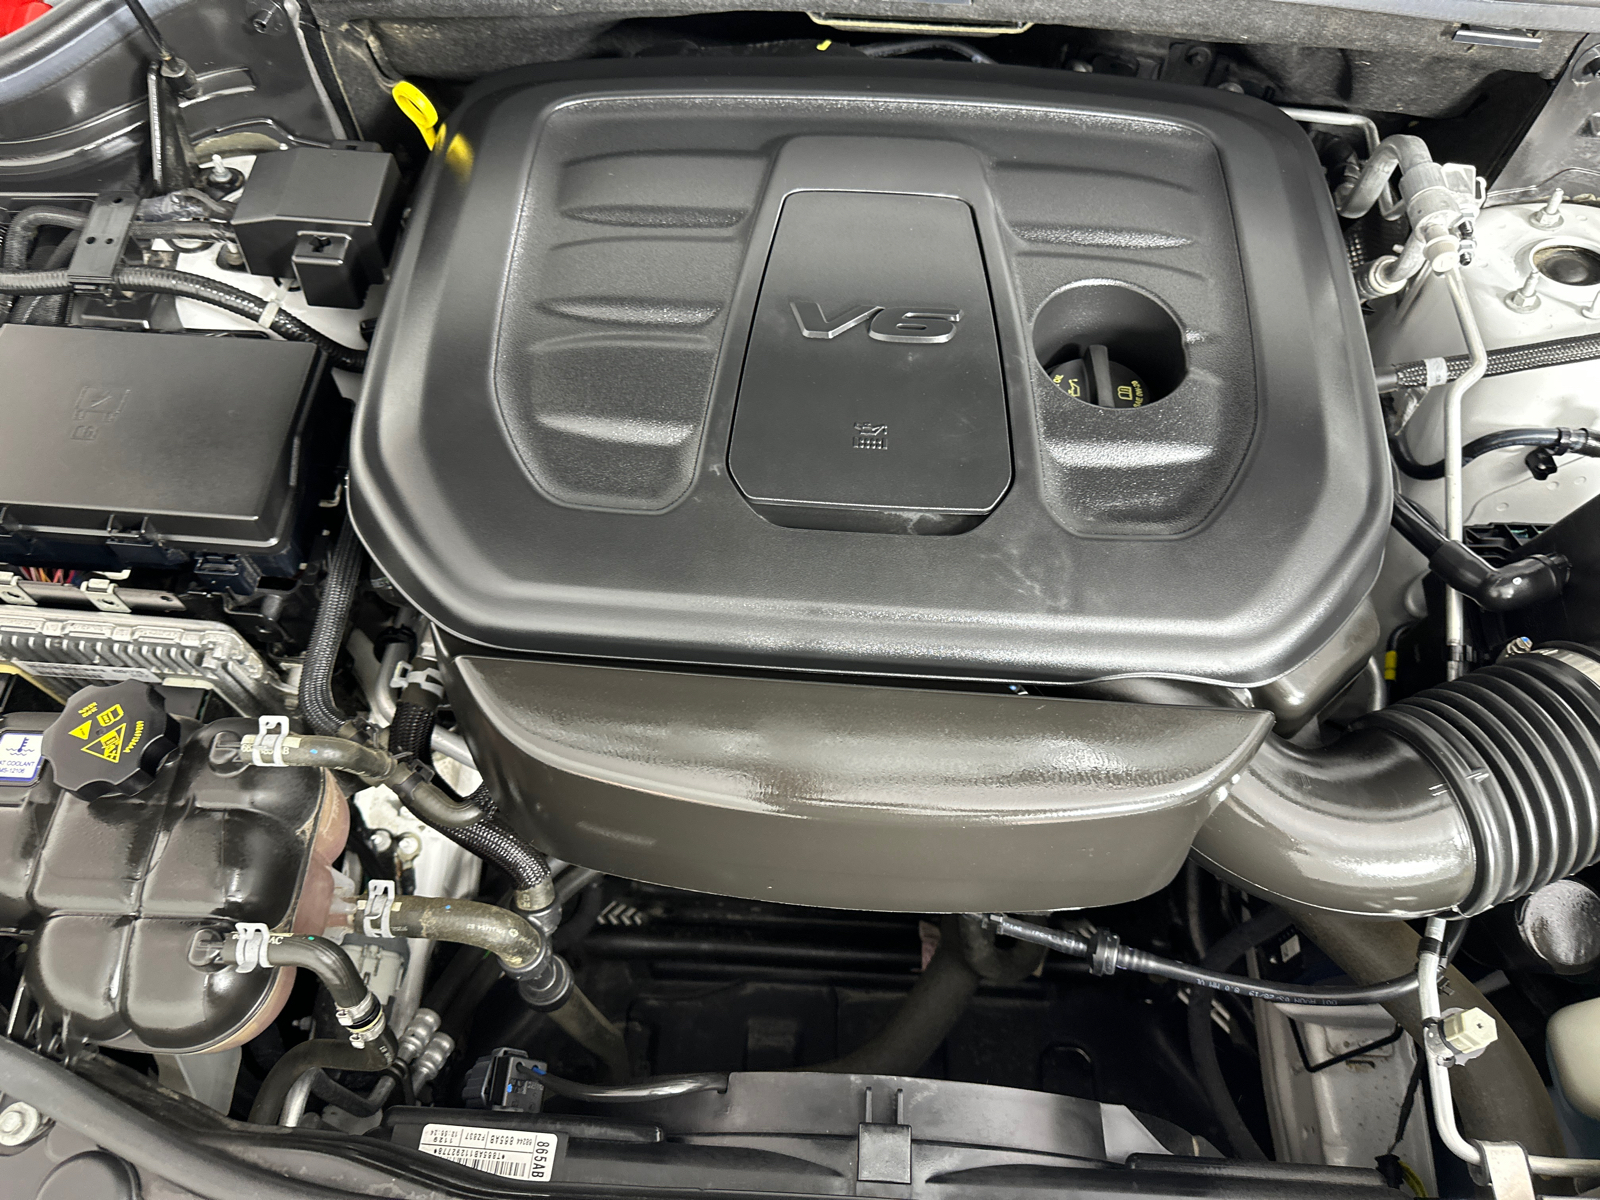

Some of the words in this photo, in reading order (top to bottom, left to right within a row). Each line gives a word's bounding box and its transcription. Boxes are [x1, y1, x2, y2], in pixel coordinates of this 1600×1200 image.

[790, 301, 965, 344] V6
[433, 1136, 453, 1144] 1129
[531, 1141, 550, 1179] 865AB
